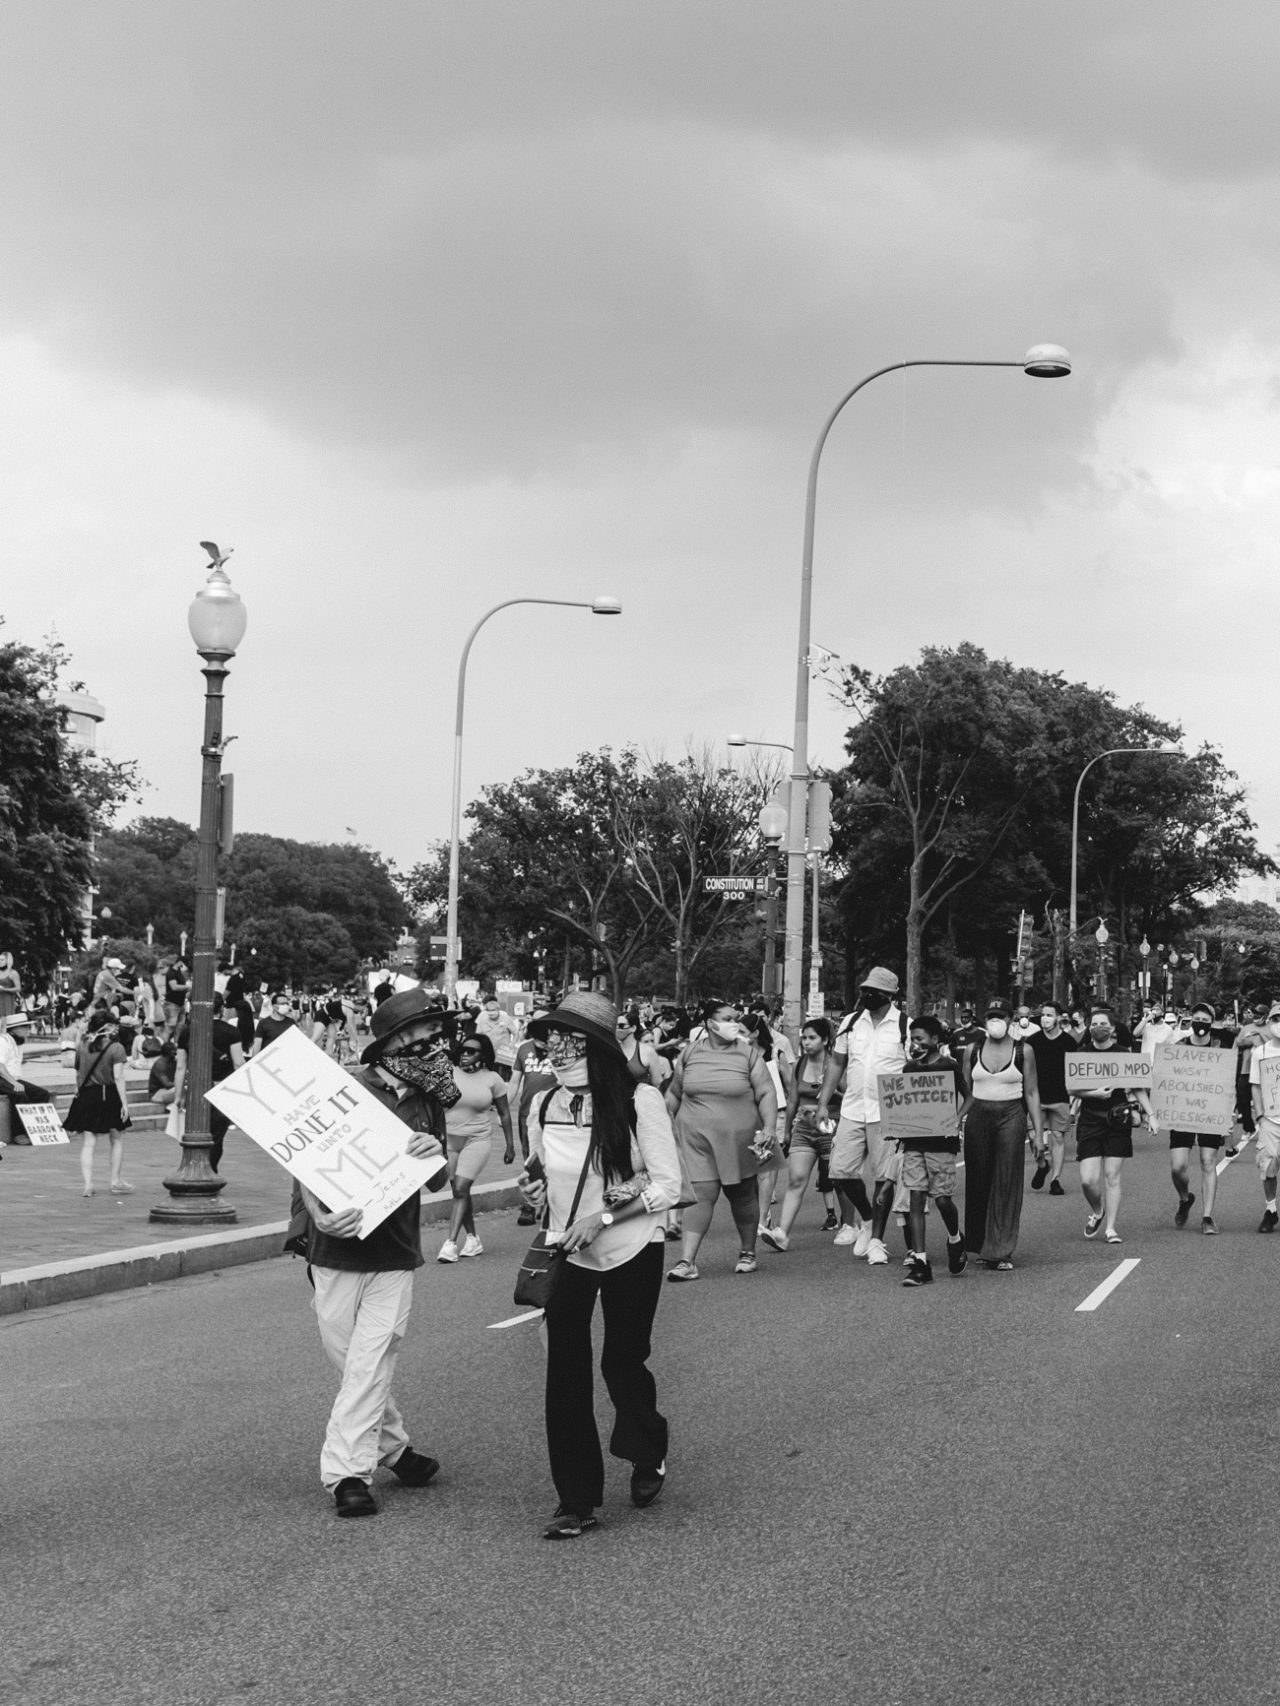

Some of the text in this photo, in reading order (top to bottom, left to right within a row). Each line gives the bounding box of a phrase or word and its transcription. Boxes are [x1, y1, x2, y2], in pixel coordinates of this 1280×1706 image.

[705, 878, 754, 890] CONSTITUTION
[722, 891, 745, 900] 300
[1163, 1047, 1222, 1063] SLAVERY
[1068, 1062, 1150, 1077] DEFUND MPD
[221, 1046, 316, 1115] YE
[882, 1074, 945, 1093] WE WANT
[1157, 1079, 1224, 1095] ABOLISHED
[883, 1089, 954, 1109] JUSTICE!
[1166, 1094, 1208, 1110] IT WAS
[19, 1106, 37, 1115] WHAT
[46, 1105, 54, 1114] IT
[282, 1094, 321, 1126] HAVE
[1156, 1108, 1225, 1125] REDESIGNED
[34, 1115, 50, 1124] WAS
[270, 1085, 359, 1163] DONE IT
[39, 1134, 59, 1143] NECK
[316, 1123, 353, 1153] UNTO
[314, 1128, 399, 1200] ME
